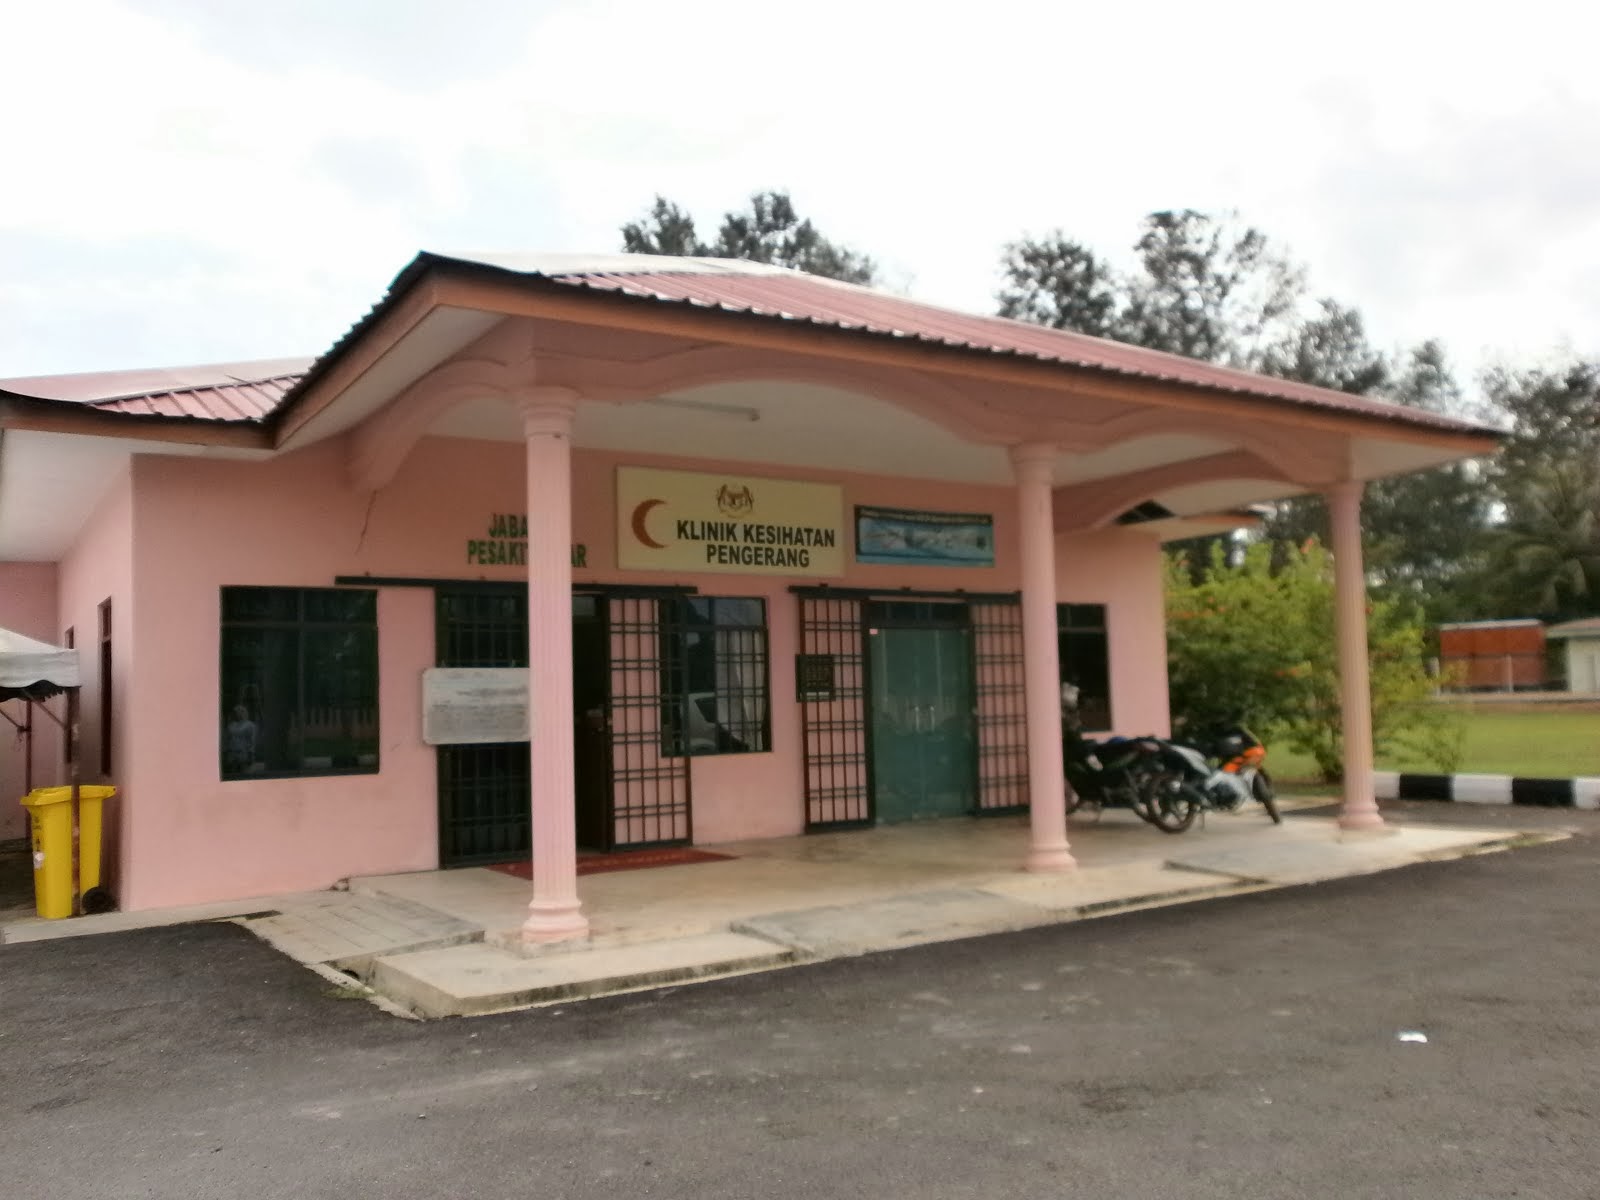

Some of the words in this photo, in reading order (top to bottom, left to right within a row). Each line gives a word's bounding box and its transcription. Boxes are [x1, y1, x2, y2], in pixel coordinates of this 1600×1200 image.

[488, 513, 528, 538] JABA
[677, 520, 738, 542] KLINIK
[743, 524, 835, 547] KESIHATAN
[467, 540, 529, 565] PESAKI
[706, 544, 810, 567] PENGERANG
